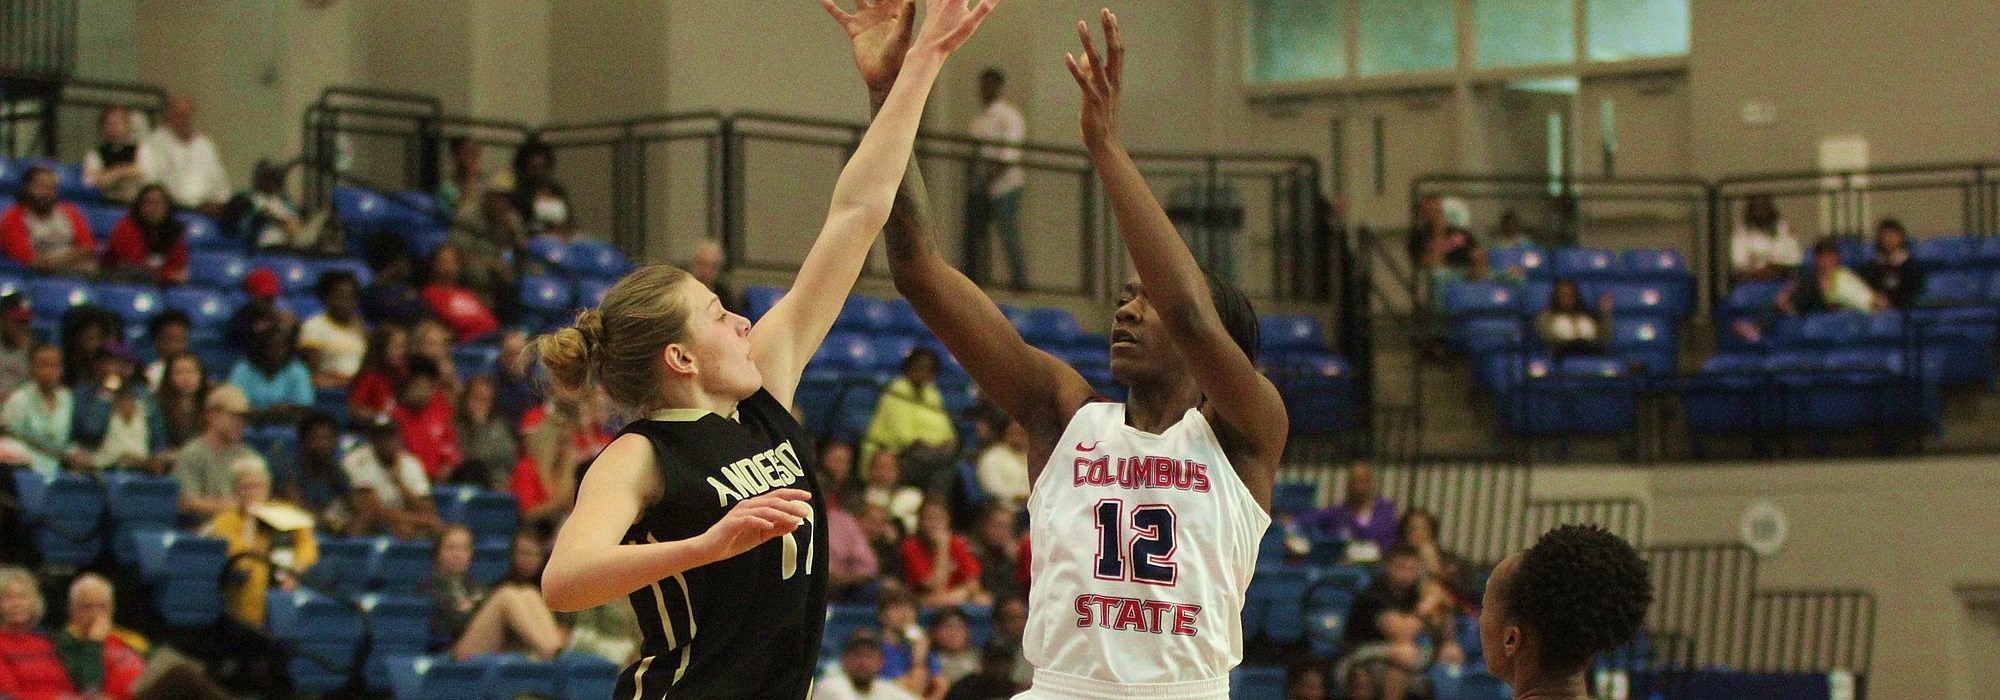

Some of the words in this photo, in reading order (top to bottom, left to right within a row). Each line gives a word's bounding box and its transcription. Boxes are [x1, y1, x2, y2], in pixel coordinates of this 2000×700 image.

[1073, 455, 1211, 493] COLUMBUS
[1094, 498, 1177, 587] 12
[1075, 594, 1202, 636] STATE
